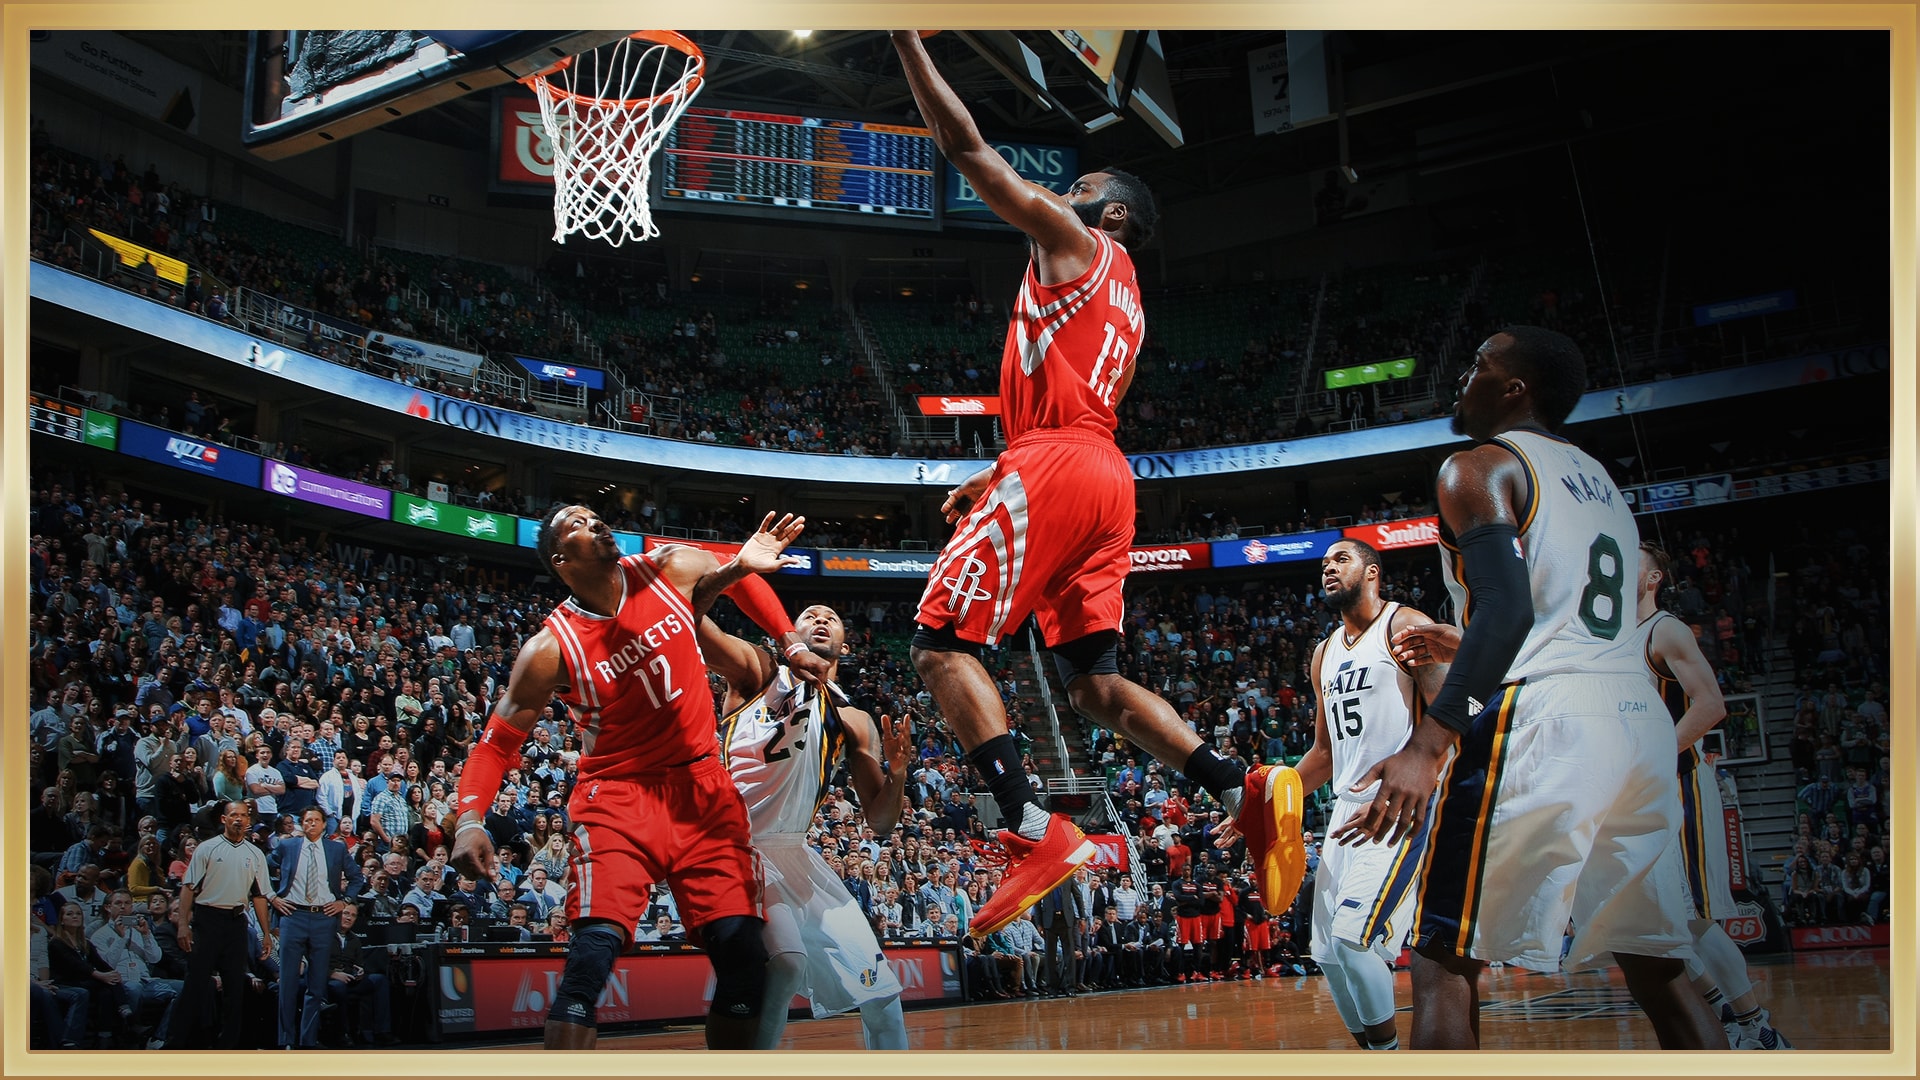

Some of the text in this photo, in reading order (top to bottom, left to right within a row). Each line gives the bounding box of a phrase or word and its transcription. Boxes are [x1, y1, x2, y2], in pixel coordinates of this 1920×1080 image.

[80, 41, 144, 77] Go Further
[1089, 321, 1130, 408] 13
[1832, 346, 1889, 377] ICO
[432, 396, 503, 436] ICON
[510, 415, 590, 441] HEALTH
[515, 428, 601, 454] FITNESS
[1190, 456, 1280, 474] FITNESS
[299, 480, 384, 509] communications
[1561, 472, 1615, 514] MACK
[1128, 549, 1192, 565] TOYOTA
[1578, 532, 1624, 641] 8
[594, 613, 683, 684] ROCKETS
[633, 654, 683, 710] 12
[1331, 697, 1364, 741] 15
[1618, 701, 1648, 713] UTAH
[1730, 857, 1743, 886] ROOT
[1729, 919, 1757, 937] 66
